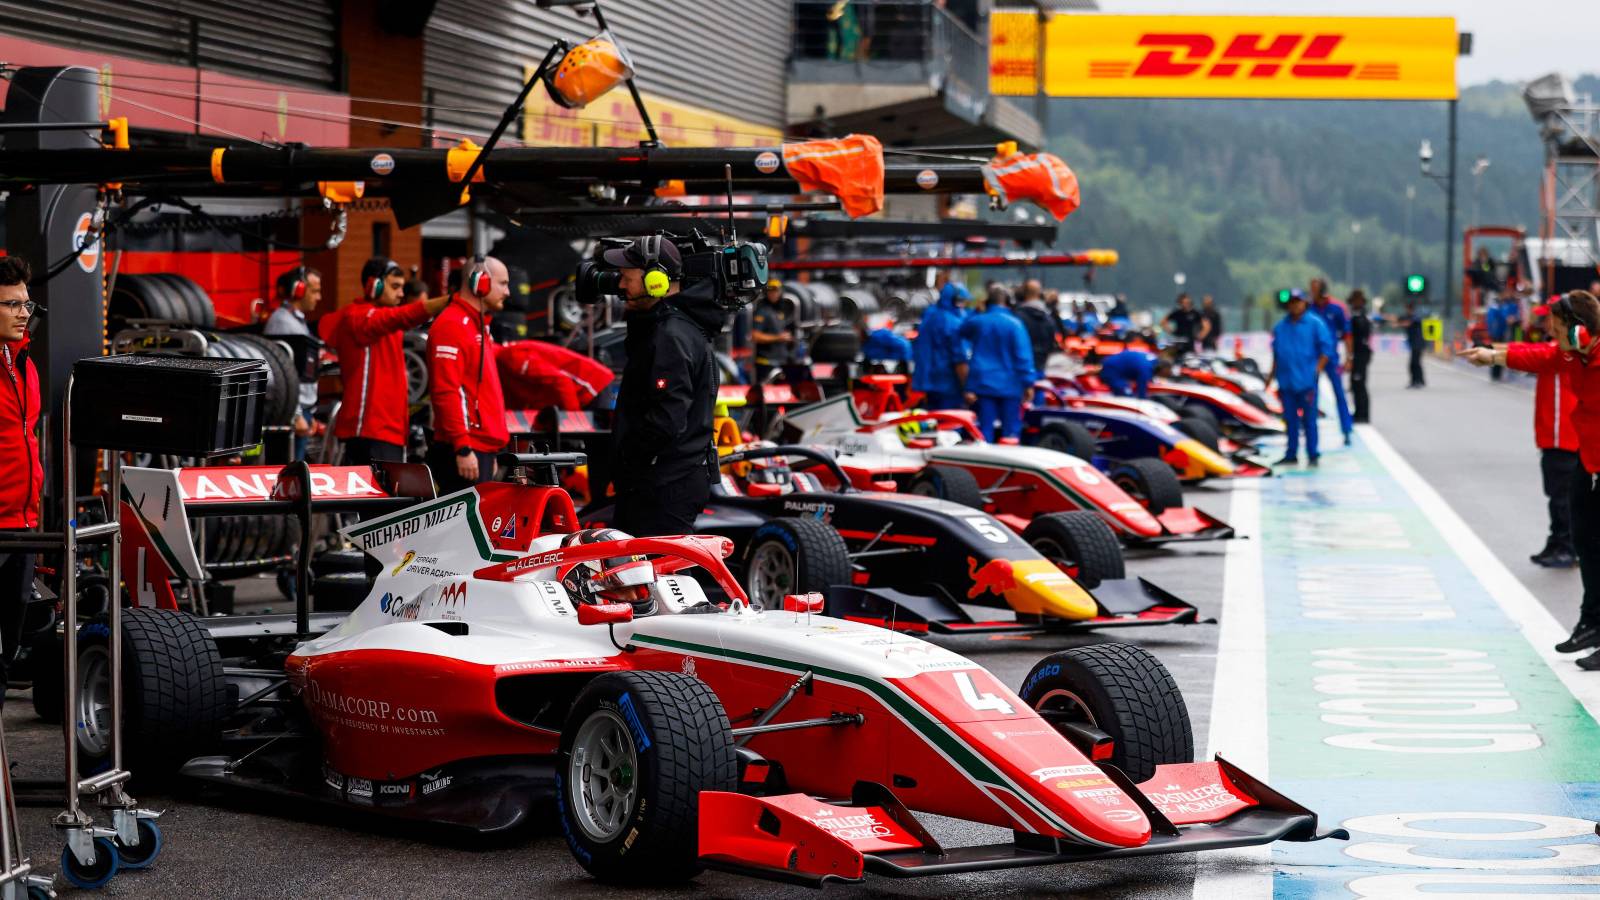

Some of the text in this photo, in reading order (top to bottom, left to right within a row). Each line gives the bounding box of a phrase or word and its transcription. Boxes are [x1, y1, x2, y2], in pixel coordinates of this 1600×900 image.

[1133, 33, 1355, 78] DHL
[178, 471, 383, 499] ANRA
[783, 500, 835, 513] PALMETTO
[362, 501, 465, 550] RICHARD MILLE
[965, 517, 1009, 543] 5
[406, 564, 430, 575] DRIVER
[952, 671, 1016, 714] 4
[1310, 646, 1544, 753] aramco
[380, 724, 389, 733] BY
[392, 726, 447, 736] INVESTMENT
[379, 784, 410, 794] KONI
